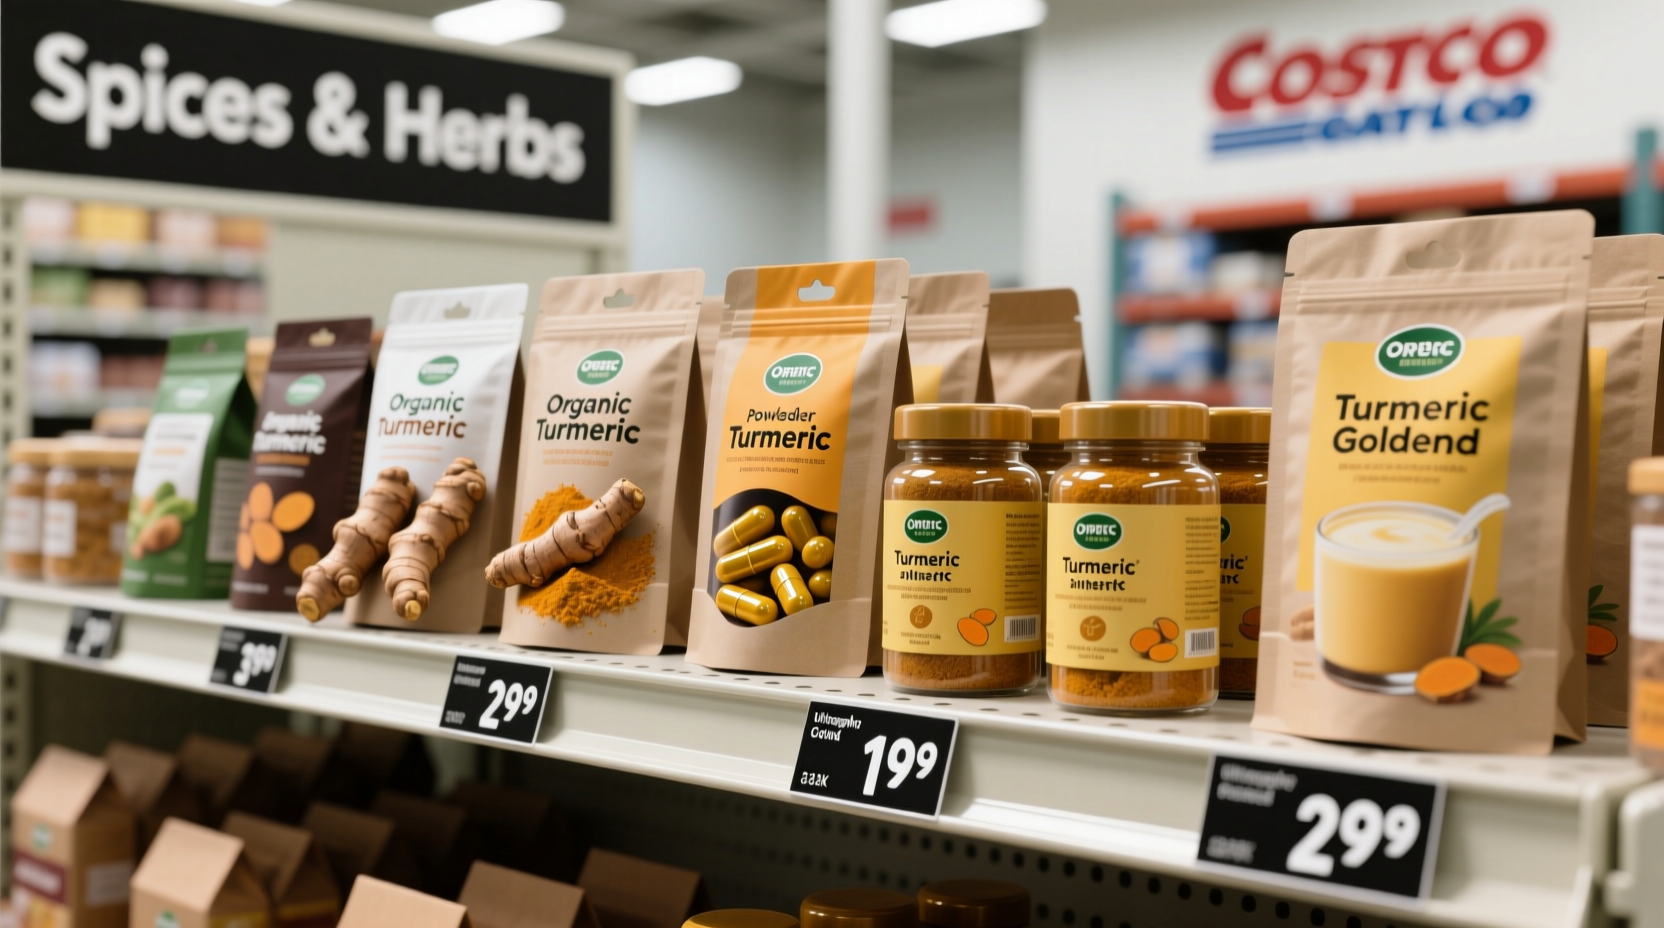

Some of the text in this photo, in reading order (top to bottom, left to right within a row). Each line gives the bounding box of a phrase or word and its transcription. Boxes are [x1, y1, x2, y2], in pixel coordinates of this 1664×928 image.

[31, 31, 586, 184] Spices & Herbs
[390, 391, 464, 416] Organic
[547, 392, 631, 419] Organic
[1336, 391, 1489, 421] Turmeric
[379, 415, 467, 438] Turmeric
[537, 415, 640, 444] Turmeric
[730, 425, 831, 450] Turmeric
[1333, 426, 1480, 455] Goldend
[895, 550, 960, 567] Turmeric
